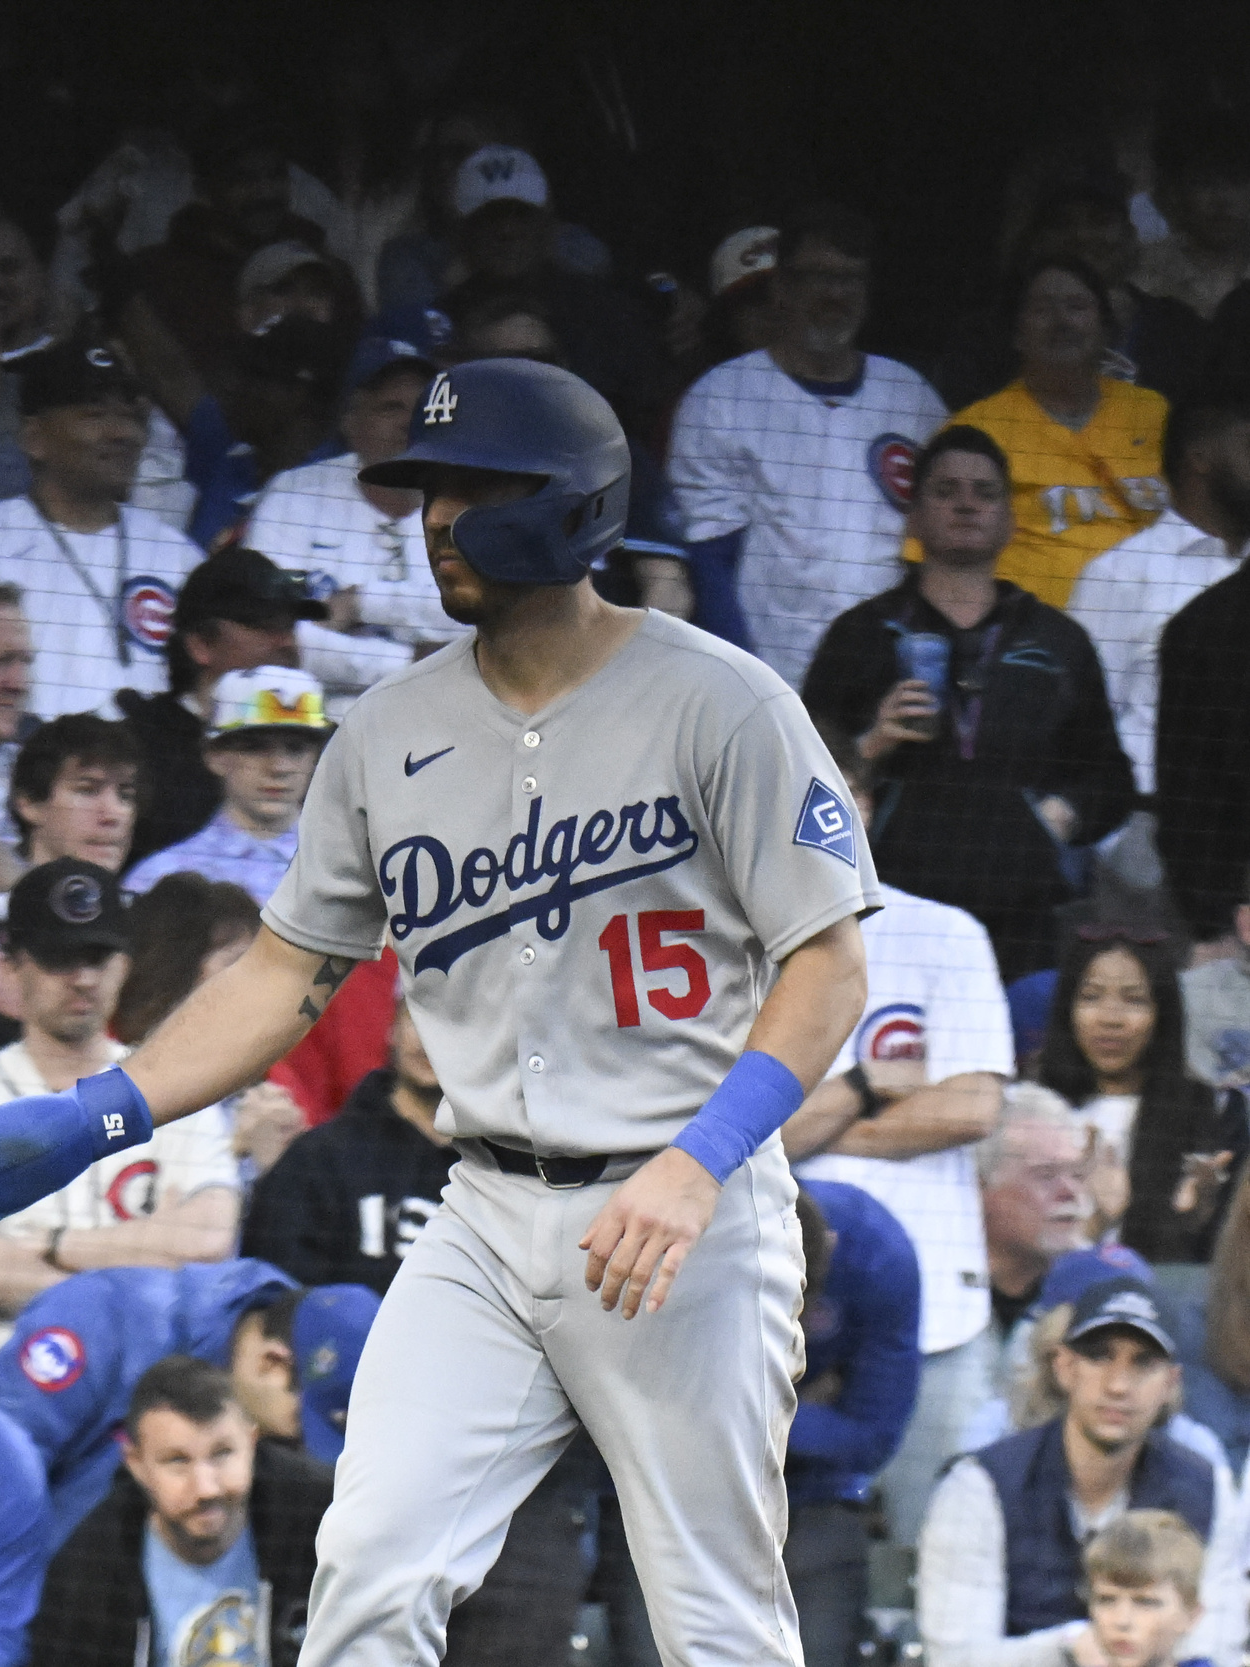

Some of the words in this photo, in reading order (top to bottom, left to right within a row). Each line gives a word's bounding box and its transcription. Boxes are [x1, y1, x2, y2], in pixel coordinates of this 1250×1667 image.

[423, 372, 458, 425] LA
[812, 800, 844, 834] G
[380, 796, 697, 942] Dodgers
[599, 908, 712, 1028] 15
[102, 1112, 126, 1141] 15
